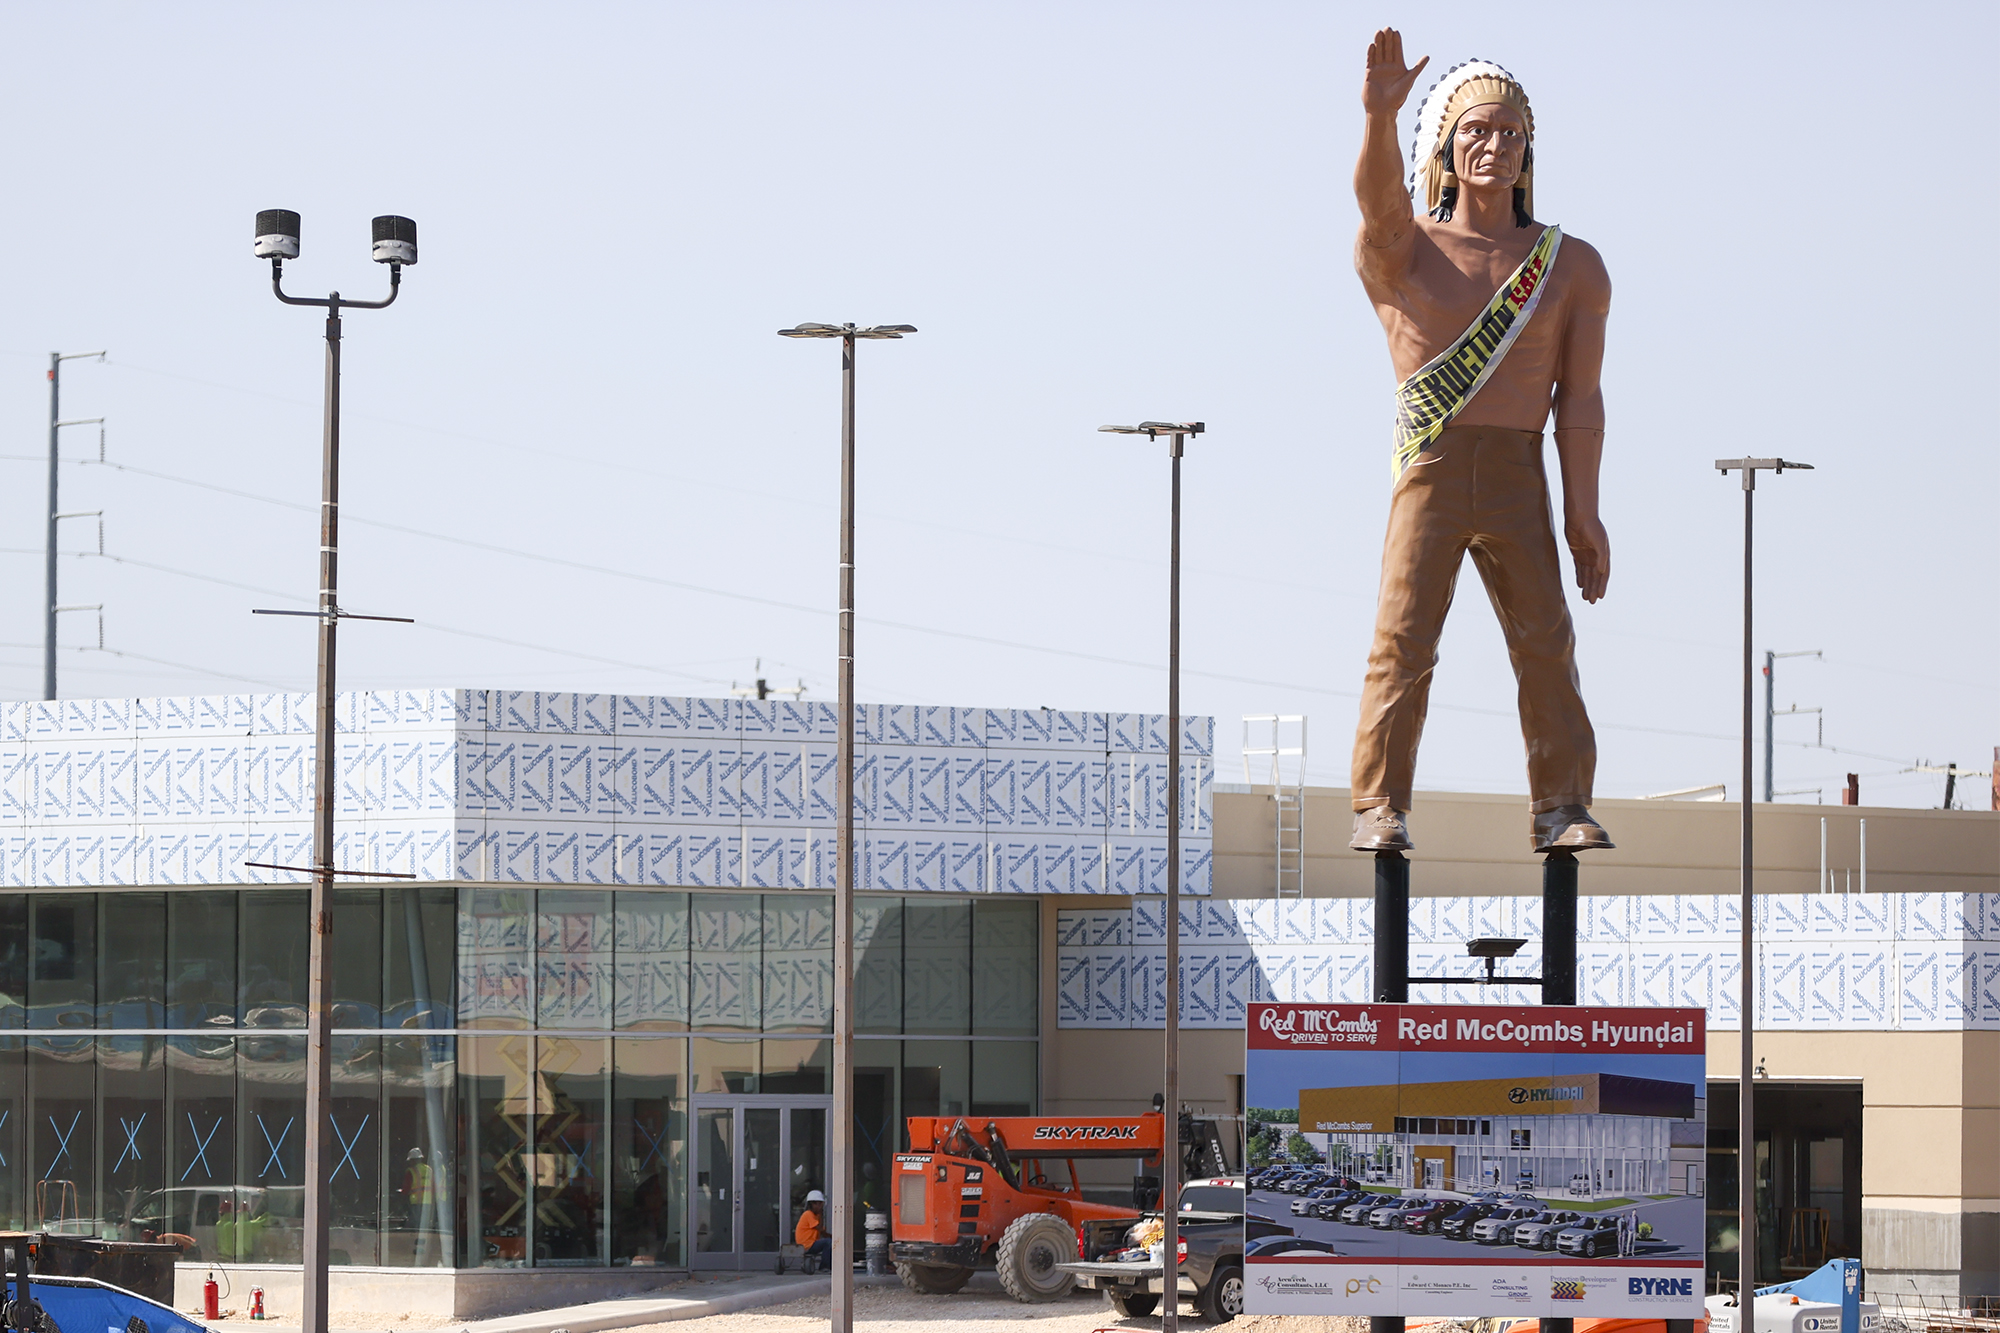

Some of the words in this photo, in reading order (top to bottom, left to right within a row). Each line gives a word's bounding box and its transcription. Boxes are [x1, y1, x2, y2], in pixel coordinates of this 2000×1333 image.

[68, 701, 95, 732] ALUCOBOND
[102, 700, 128, 731] ALUCOBOND
[167, 698, 192, 729] ALUCOBOND
[660, 698, 690, 730] ALUCOBOND
[697, 700, 727, 732] ALUCOBOND
[745, 701, 775, 733] ALUCOBOND
[782, 702, 812, 734] ALUCOBOND
[1022, 711, 1050, 743] ALUCOBOND
[1058, 713, 1086, 743] ALUCOBOND
[44, 752, 72, 781] ALUCOBOND
[77, 751, 104, 781] ALUCOBOND
[143, 749, 170, 780] ALUCOBOND
[176, 748, 204, 779] ALUCOBOND
[210, 747, 238, 778] ALUCOBOND
[392, 742, 423, 774] ALUCOBOND
[522, 743, 553, 775] ALUCOBOND
[560, 744, 591, 776] ALUCOBOND
[644, 747, 674, 779] ALUCOBOND
[682, 749, 712, 780] ALUCOBOND
[884, 755, 914, 786] ALUCOBOND
[920, 756, 950, 787] ALUCOBOND
[956, 758, 984, 787] ALUCOBOND
[1022, 759, 1050, 790] ALUCOBOND
[1057, 761, 1085, 790] ALUCOBOND
[44, 787, 70, 818] ALUCOBOND
[77, 786, 102, 817] ALUCOBOND
[142, 785, 169, 816] ALUCOBOND
[176, 784, 202, 815] ALUCOBOND
[521, 780, 552, 813] ALUCOBOND
[559, 781, 590, 814] ALUCOBOND
[643, 784, 674, 817] ALUCOBOND
[681, 786, 711, 818] ALUCOBOND
[883, 791, 911, 823] ALUCOBOND
[919, 792, 947, 824] ALUCOBOND
[955, 793, 983, 825] ALUCOBOND
[1021, 795, 1049, 827] ALUCOBOND
[1056, 796, 1084, 828] ALUCOBOND
[42, 837, 70, 866] ALUCOBOND
[159, 835, 188, 866] ALUCOBOND
[385, 831, 414, 862] ALUCOBOND
[507, 830, 539, 862] ALUCOBOND
[547, 831, 578, 863] ALUCOBOND
[650, 834, 682, 866] ALUCOBOND
[689, 835, 720, 867] ALUCOBOND
[752, 837, 783, 867] ALUCOBOND
[878, 840, 908, 871] ALUCOBOND
[915, 841, 945, 872] ALUCOBOND
[952, 842, 982, 873] ALUCOBOND
[1008, 843, 1038, 875] ALUCOBOND
[1136, 907, 1164, 938] ALUCOBOND
[1208, 907, 1235, 936] ALUCOBOND
[1648, 902, 1678, 934] ALUCOBOND
[1775, 901, 1806, 933] ALUCOBOND
[1815, 901, 1846, 933] ALUCOBOND
[1854, 901, 1886, 933] ALUCOBOND
[1097, 956, 1125, 986] ALUCOBOND
[1190, 955, 1219, 987] ALUCOBOND
[1304, 955, 1332, 985] ALUCOBOND
[1340, 954, 1369, 986] ALUCOBOND
[1643, 952, 1674, 985] ALUCOBOND
[1681, 952, 1713, 985] ALUCOBOND
[1773, 952, 1805, 985] ALUCOBOND
[1813, 952, 1845, 985] ALUCOBOND
[1853, 952, 1885, 985] ALUCOBOND
[1904, 951, 1937, 984] ALUCOBOND
[1060, 991, 1088, 1020] ALUCOBOND
[1095, 992, 1123, 1021] ALUCOBOND
[1190, 992, 1218, 1021] ALUCOBOND
[1772, 990, 1803, 1022] ALUCOBOND
[1811, 990, 1843, 1022] ALUCOBOND
[1851, 990, 1883, 1022] ALUCOBOND
[1902, 989, 1936, 1022] ALUCOBOND
[1259, 1008, 1296, 1040] Red
[1298, 1010, 1378, 1033] McCombs
[1291, 1033, 1328, 1042] DRIVEN
[1331, 1034, 1344, 1042] TO
[1346, 1034, 1378, 1042] SERVE
[1398, 1018, 1447, 1040] Red
[1456, 1018, 1584, 1041] McCombs
[1592, 1021, 1694, 1047] Hyundai
[1530, 1087, 1584, 1102] HYUNDAI
[1034, 1126, 1140, 1139] SKYTRAK
[1316, 1122, 1326, 1130] Red
[1327, 1122, 1350, 1130] McCombs
[1351, 1121, 1373, 1132] Superior
[967, 1172, 981, 1180] JLG
[1628, 1277, 1692, 1296] BYRNE
[1845, 1268, 1858, 1277] S-40
